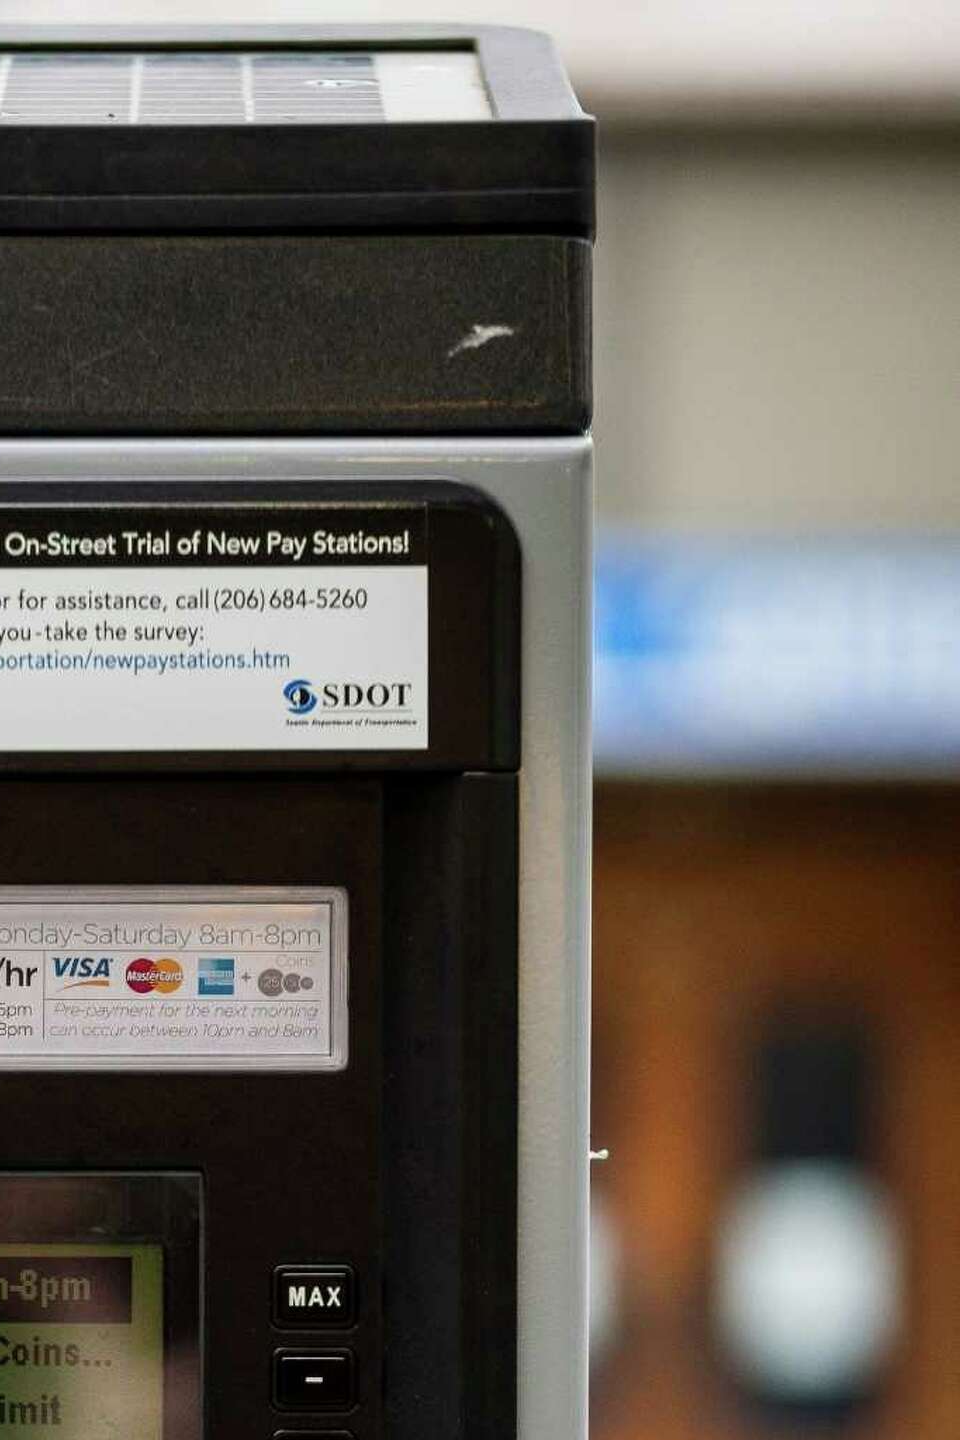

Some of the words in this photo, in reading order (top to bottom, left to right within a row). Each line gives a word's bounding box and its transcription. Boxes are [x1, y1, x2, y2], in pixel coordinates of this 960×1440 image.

[5, 532, 116, 556] On-Street
[122, 531, 169, 555] Trial
[177, 531, 201, 555] of
[208, 532, 260, 554] New
[268, 532, 306, 560] Pay
[314, 531, 408, 554] Stations!
[19, 589, 46, 610] for
[56, 590, 166, 612] assistance,
[95, 620, 126, 641] the
[135, 627, 203, 646] survey:
[323, 684, 411, 706] SDOT
[200, 923, 321, 949] 8am-8pm
[53, 958, 109, 977] VISA
[160, 1002, 181, 1015] for
[186, 1002, 209, 1016] the
[215, 1003, 246, 1016] next
[129, 1023, 196, 1037] between
[248, 1023, 277, 1037] and
[289, 1287, 340, 1306] MAX
